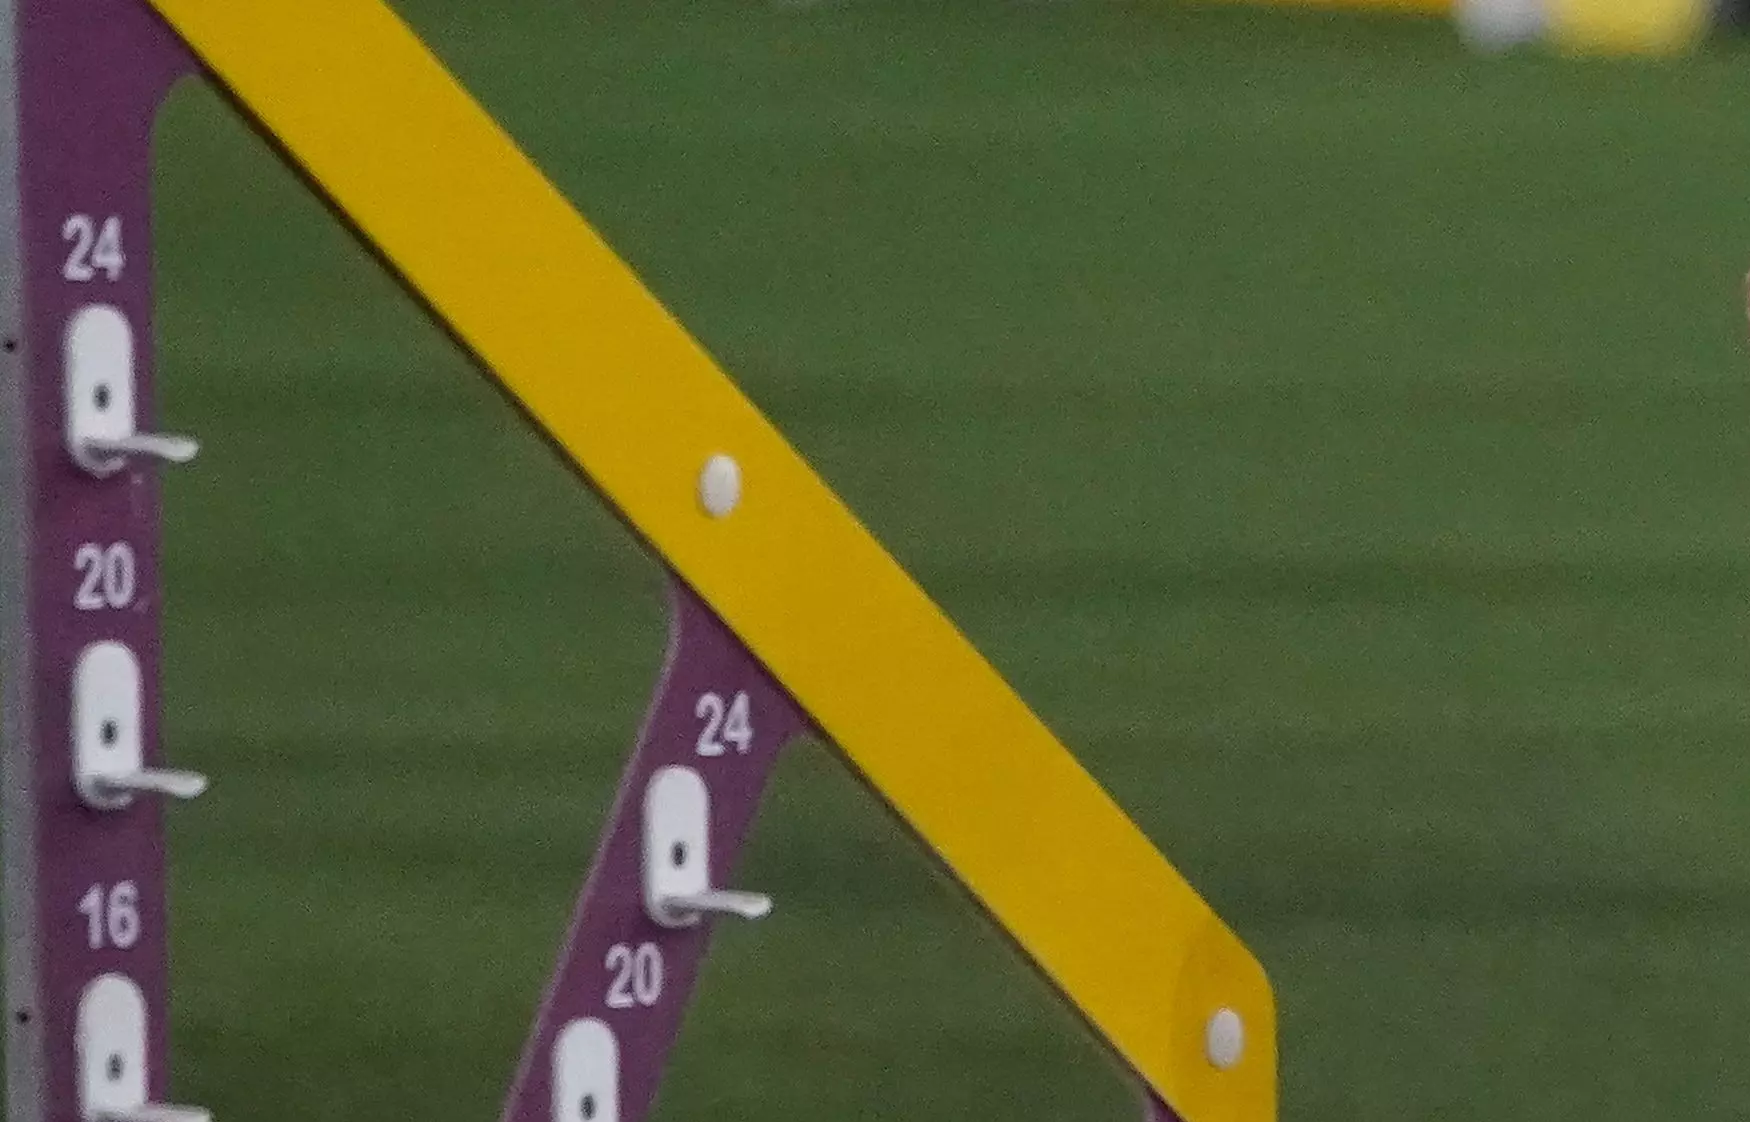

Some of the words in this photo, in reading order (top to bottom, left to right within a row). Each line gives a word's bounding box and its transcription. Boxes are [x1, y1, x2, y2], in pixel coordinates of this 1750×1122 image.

[63, 214, 125, 281] 24
[74, 542, 135, 610] 20
[695, 692, 753, 757] 24
[79, 880, 140, 949] 16
[605, 942, 664, 1009] 20
